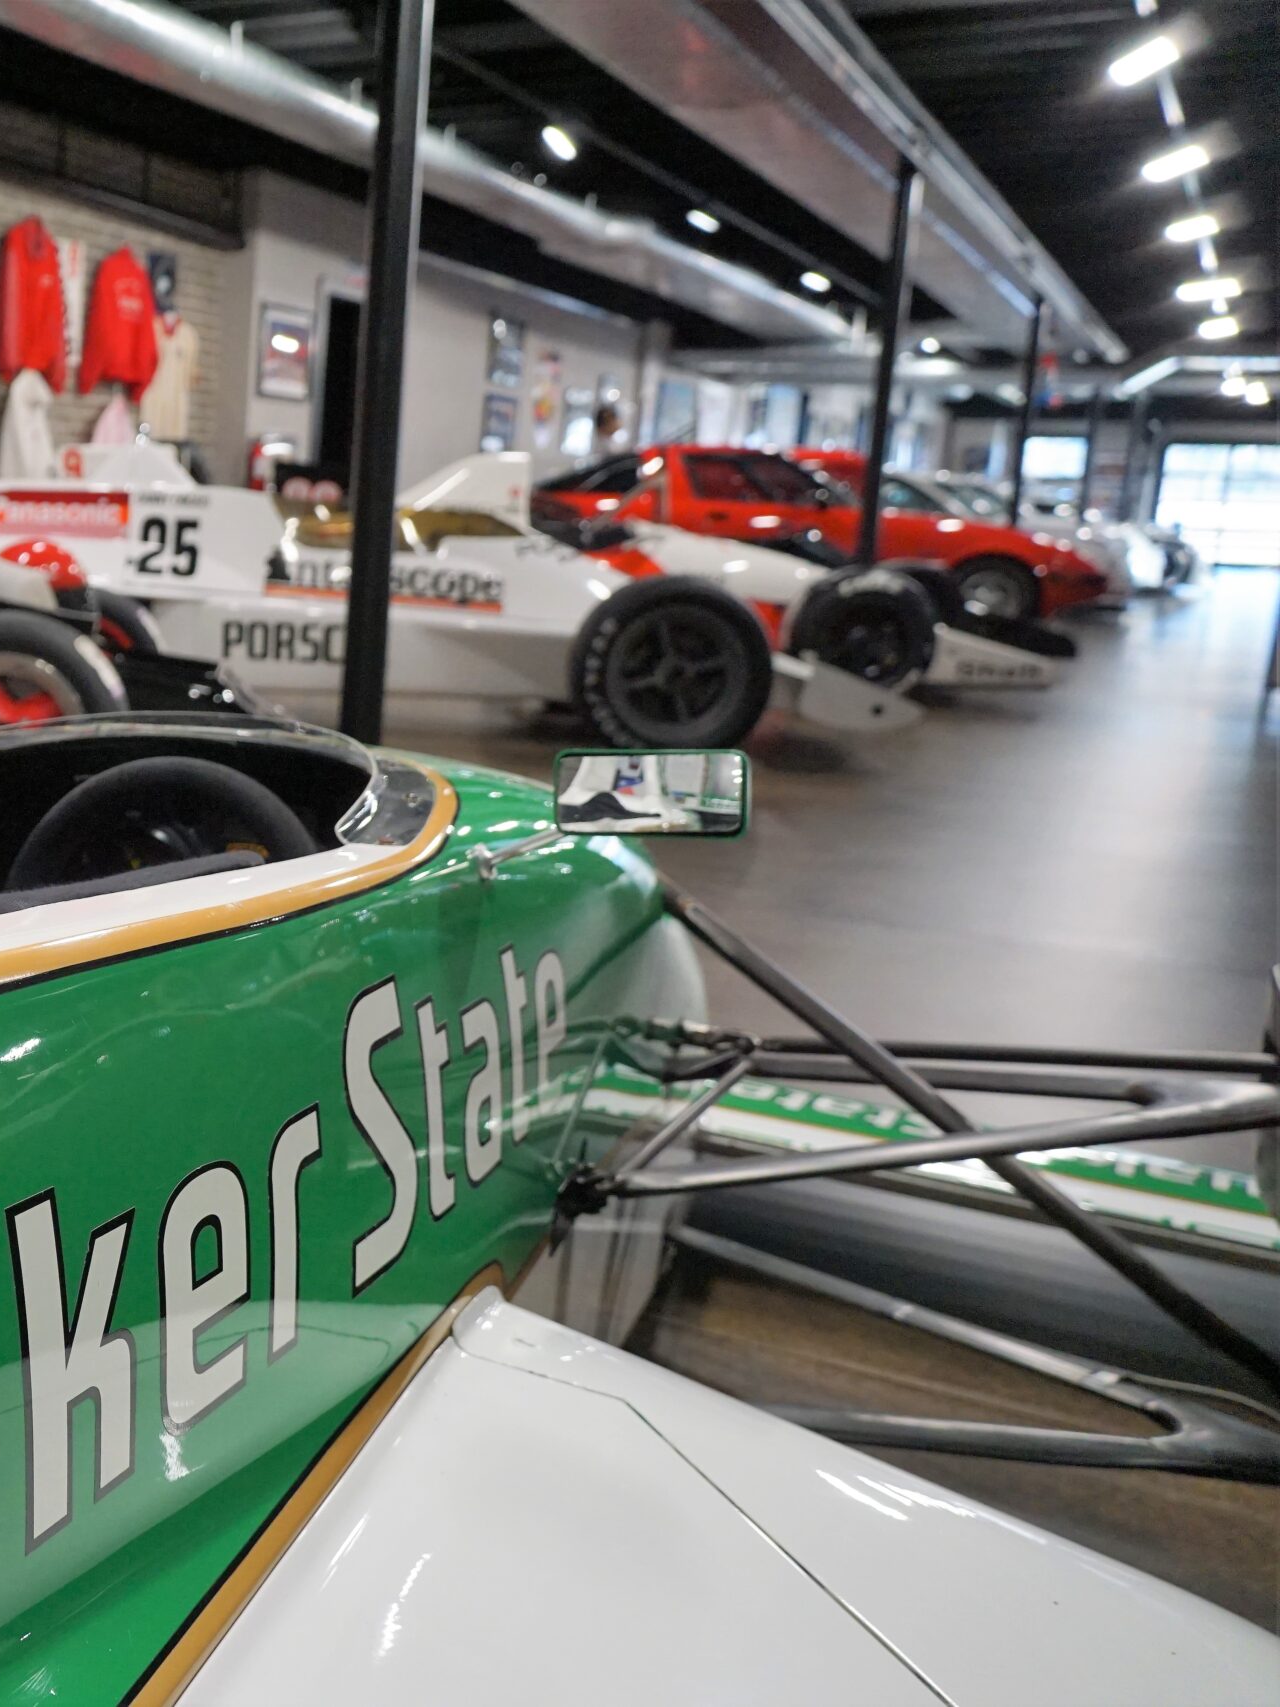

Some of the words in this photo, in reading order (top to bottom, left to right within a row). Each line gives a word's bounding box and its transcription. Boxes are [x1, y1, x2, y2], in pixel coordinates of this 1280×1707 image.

[136, 516, 200, 577] 25
[222, 621, 348, 663] PORSC
[342, 942, 569, 1299] State
